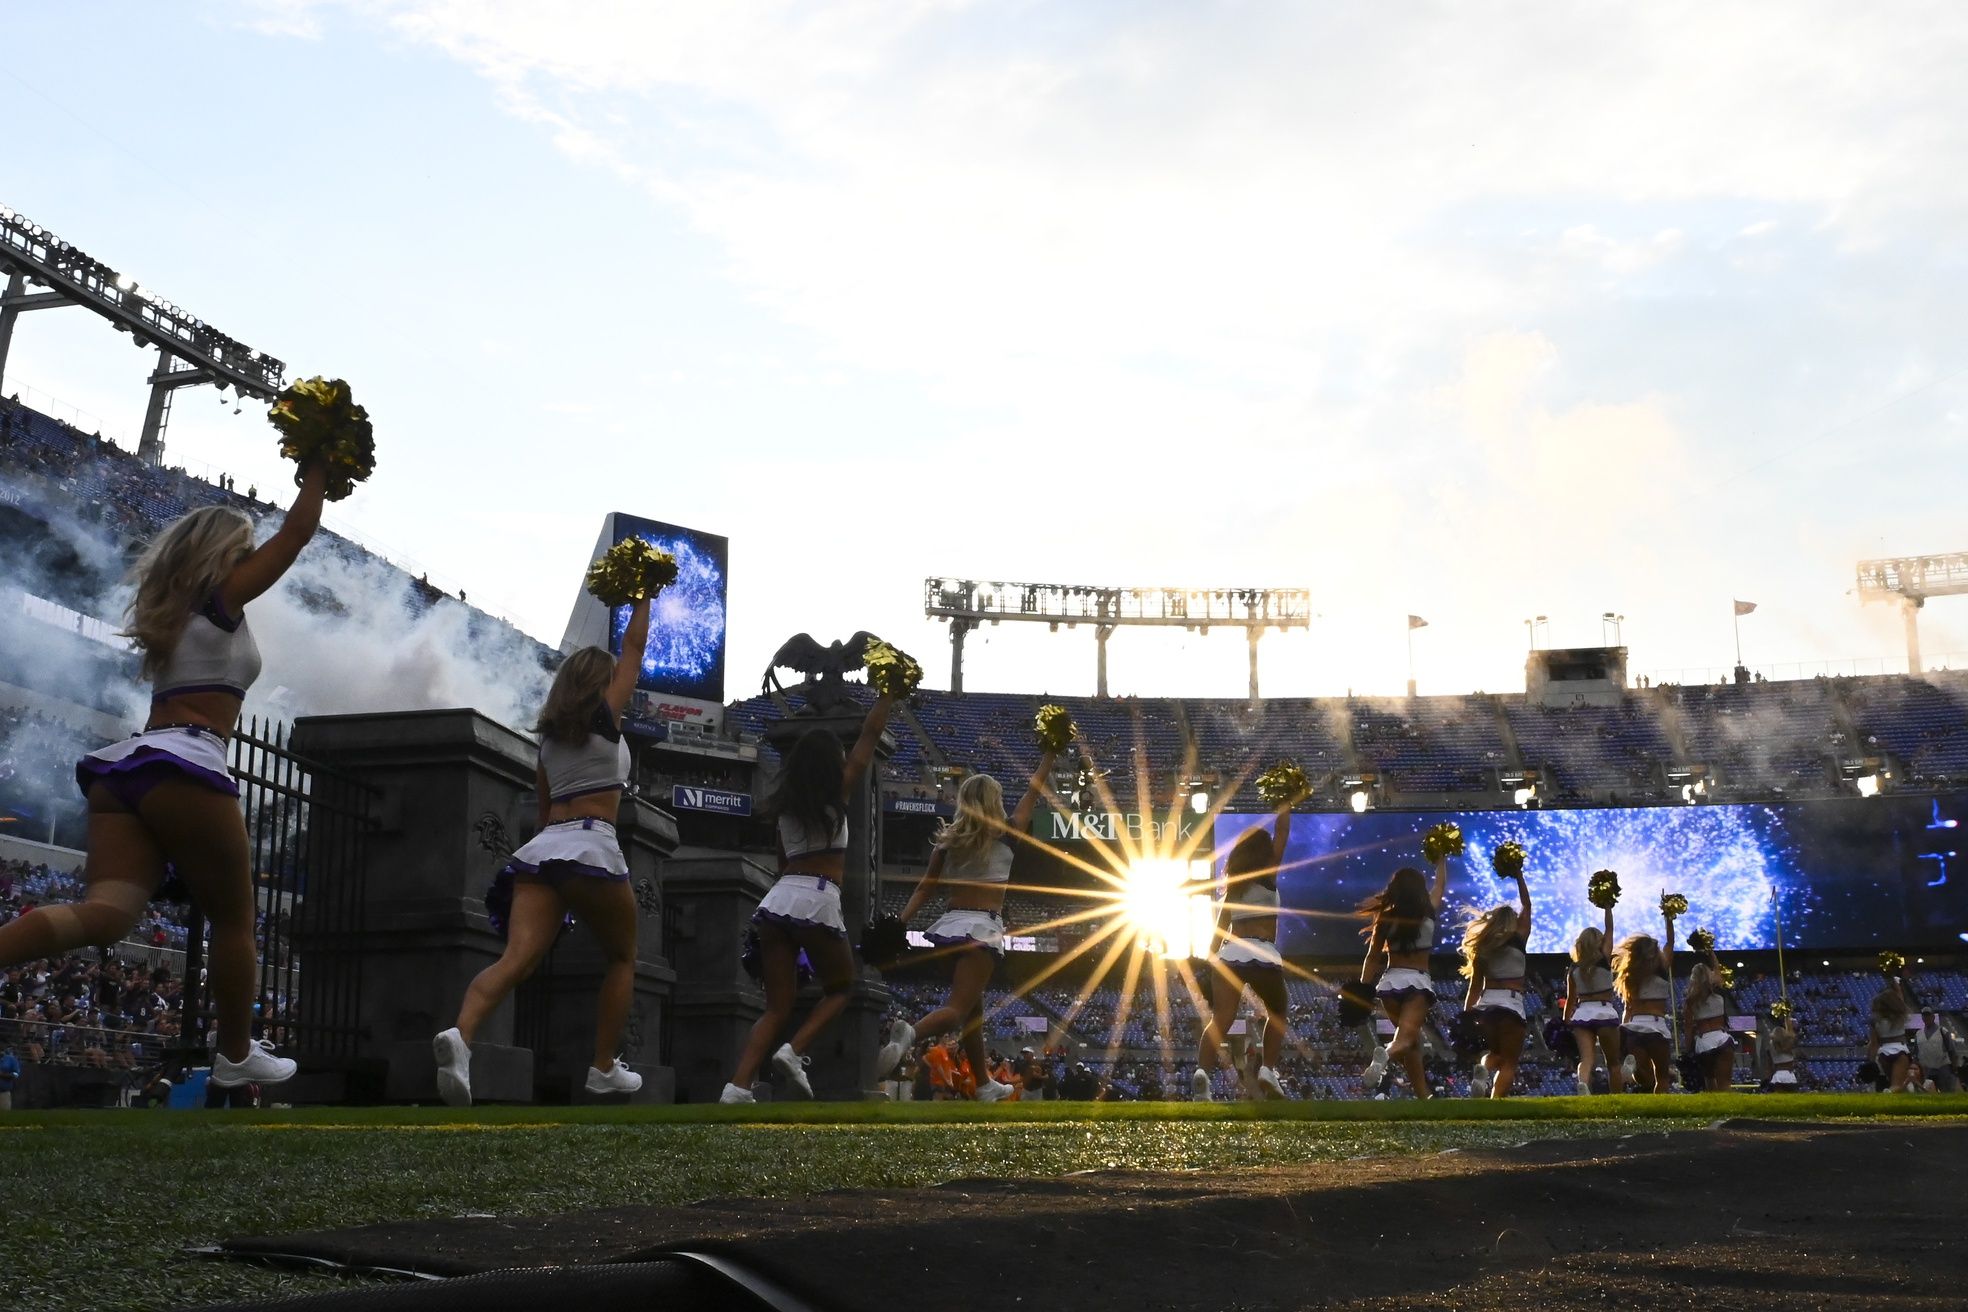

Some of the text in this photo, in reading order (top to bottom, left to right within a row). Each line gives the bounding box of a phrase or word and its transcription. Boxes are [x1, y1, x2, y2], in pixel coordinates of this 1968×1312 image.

[705, 794, 742, 807] merritt
[895, 801, 936, 813] #RAVENSFLOCK
[1051, 812, 1193, 841] M&T Bank
